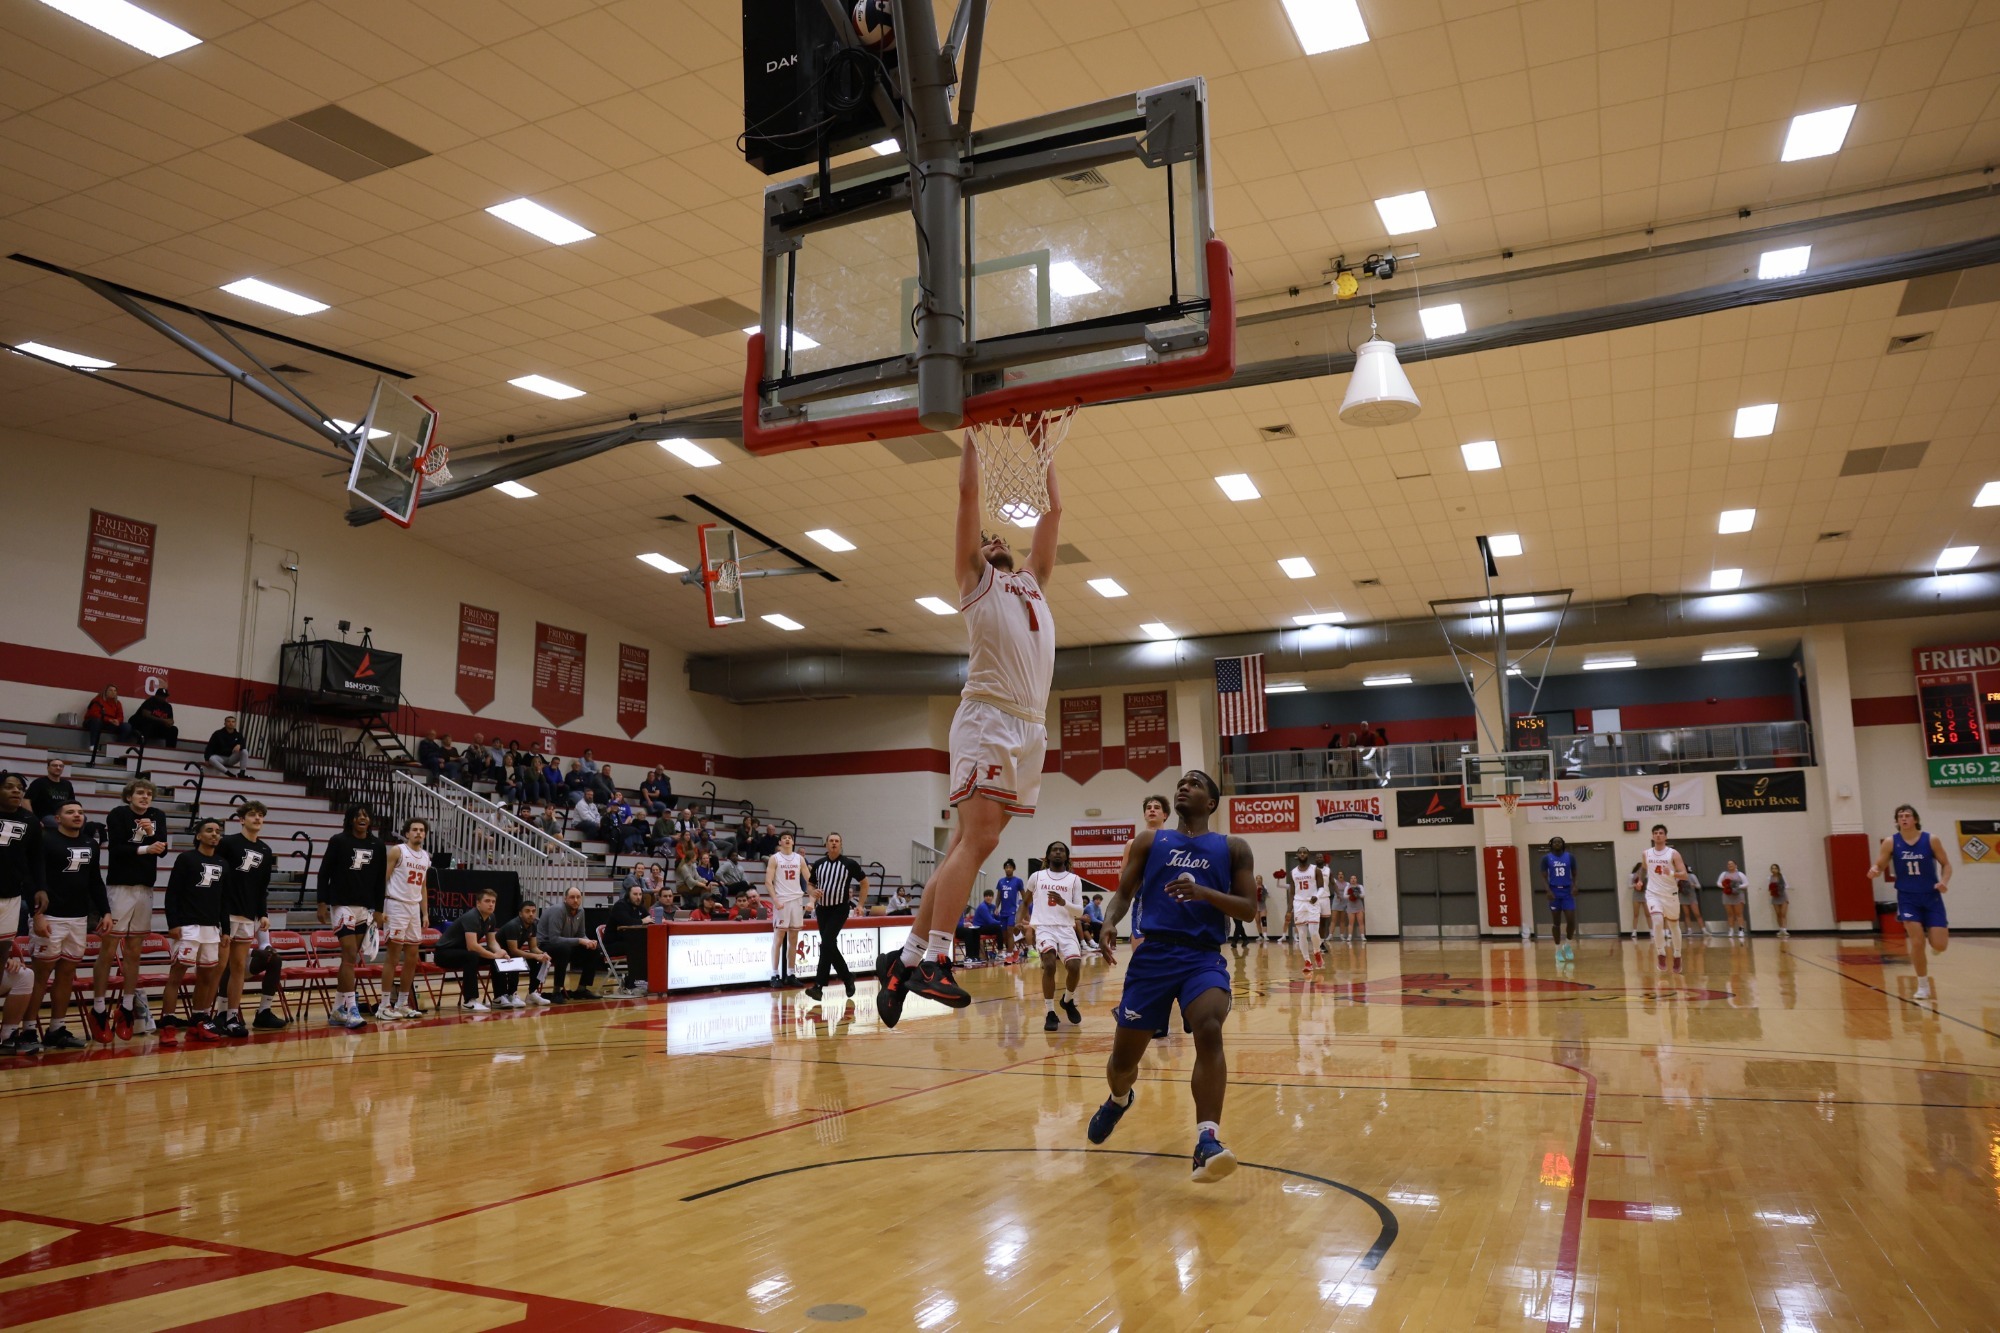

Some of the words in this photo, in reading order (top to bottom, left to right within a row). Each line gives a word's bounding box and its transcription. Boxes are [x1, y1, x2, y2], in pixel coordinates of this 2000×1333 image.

[97, 514, 149, 537] FRIENDS
[95, 526, 149, 543] UNIVERSITY
[464, 606, 495, 622] FRIENDS
[1025, 600, 1039, 632] 1
[548, 627, 575, 641] FRIENDS
[138, 665, 168, 675] SECTION
[1064, 699, 1097, 708] FRIENDS
[1128, 694, 1162, 703] FRIENDS
[1516, 718, 1544, 729] 14:54
[1949, 732, 1958, 743] 0
[984, 765, 1002, 780] F
[1940, 762, 1984, 777] (316)
[1234, 799, 1294, 812] McCOWN
[1542, 803, 1576, 811] Controls
[1664, 803, 1690, 811] SPORTS
[1725, 797, 1765, 808] EQUITY
[1769, 796, 1800, 806] BANK
[1235, 812, 1294, 825] GORDON
[62, 847, 92, 872] F
[236, 849, 263, 872] F
[349, 848, 374, 870] F
[1166, 848, 1210, 869] Tabor
[1901, 851, 1924, 859] Tabor
[406, 862, 427, 872] FALCONS
[1072, 860, 1122, 868] RIENDSATHLETICS.COM
[1906, 861, 1921, 876] 11
[195, 862, 223, 888] F
[407, 871, 424, 886] 23
[784, 870, 796, 880] 12
[1555, 867, 1565, 877] 13
[1041, 884, 1068, 892] FALCONS
[1299, 881, 1309, 890] 15
[1496, 849, 1508, 925] FALCONS
[427, 888, 476, 908] FRIEN
